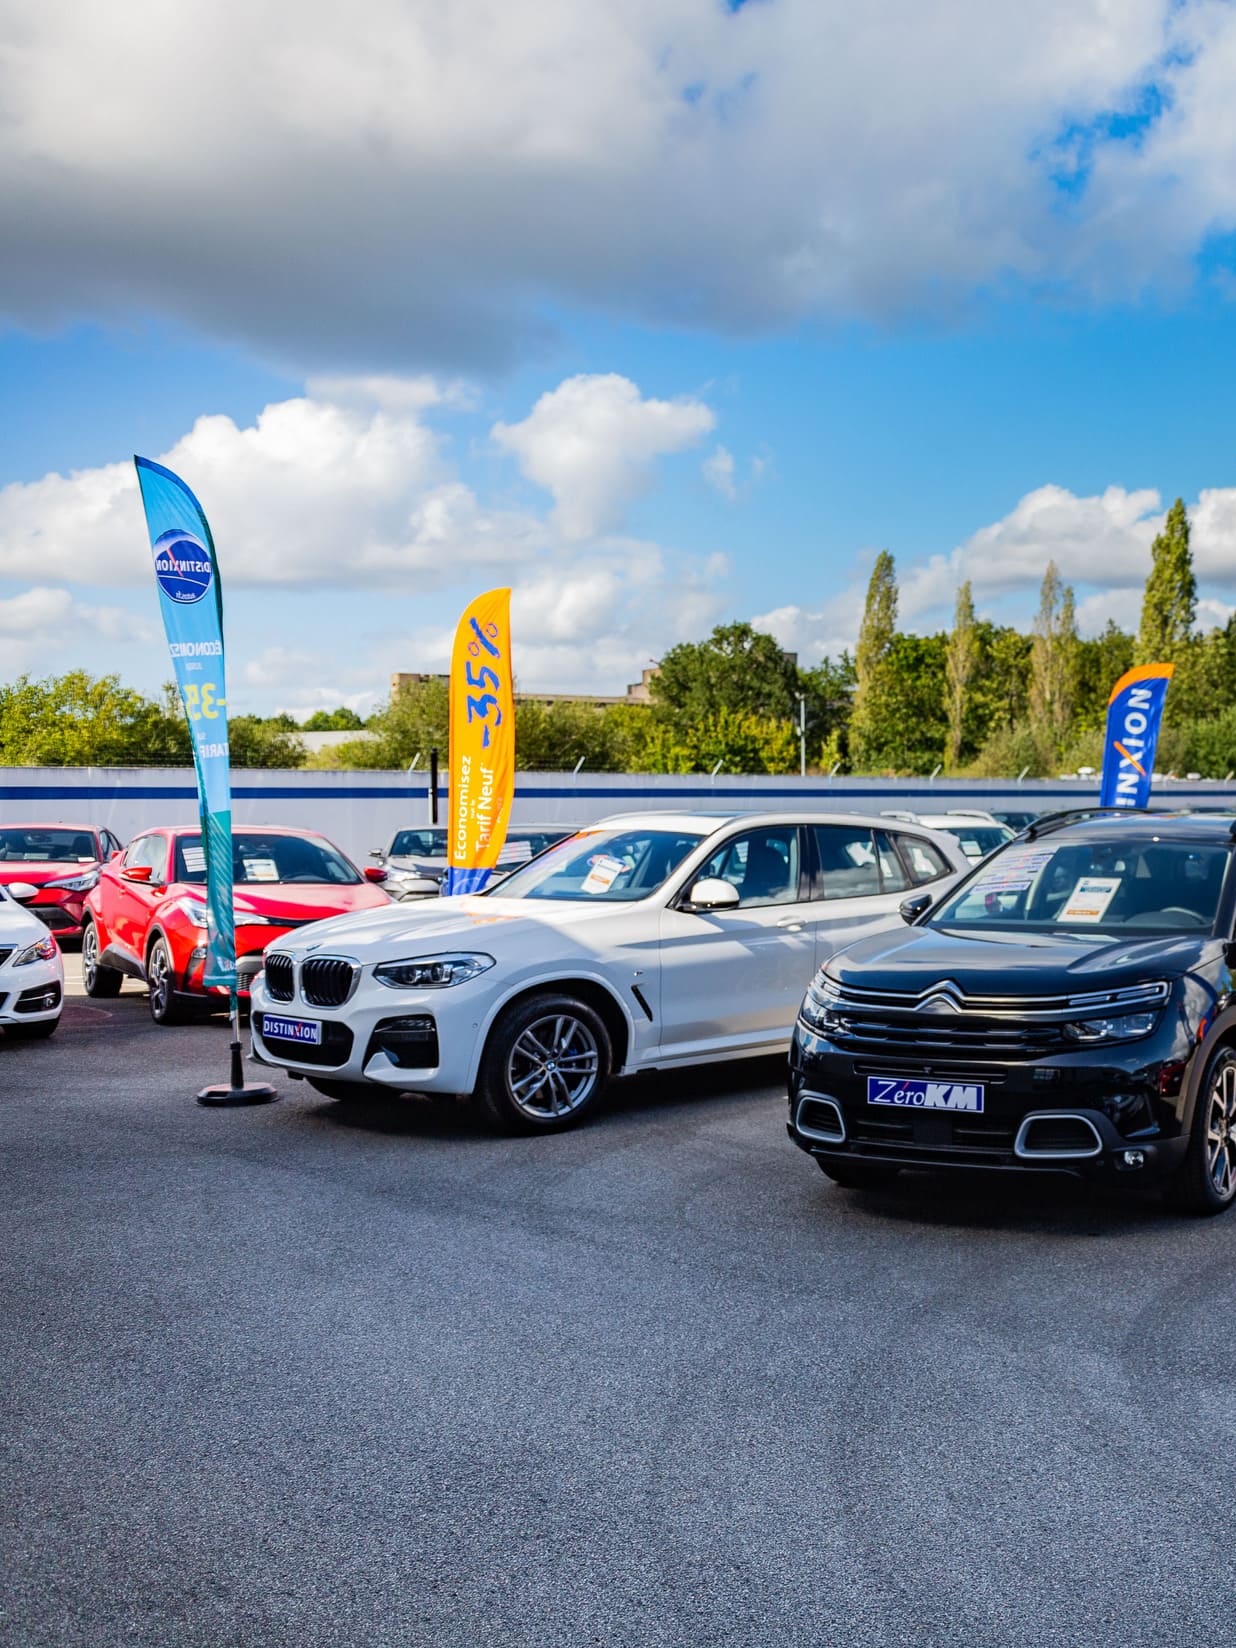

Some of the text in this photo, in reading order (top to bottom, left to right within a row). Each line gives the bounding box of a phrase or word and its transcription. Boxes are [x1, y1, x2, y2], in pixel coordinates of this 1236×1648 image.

[465, 616, 502, 749] -35%
[1113, 688, 1152, 806] INXION
[454, 755, 471, 860] Economisez
[475, 813, 491, 852] Tarif
[264, 1020, 318, 1040] DISTINXION
